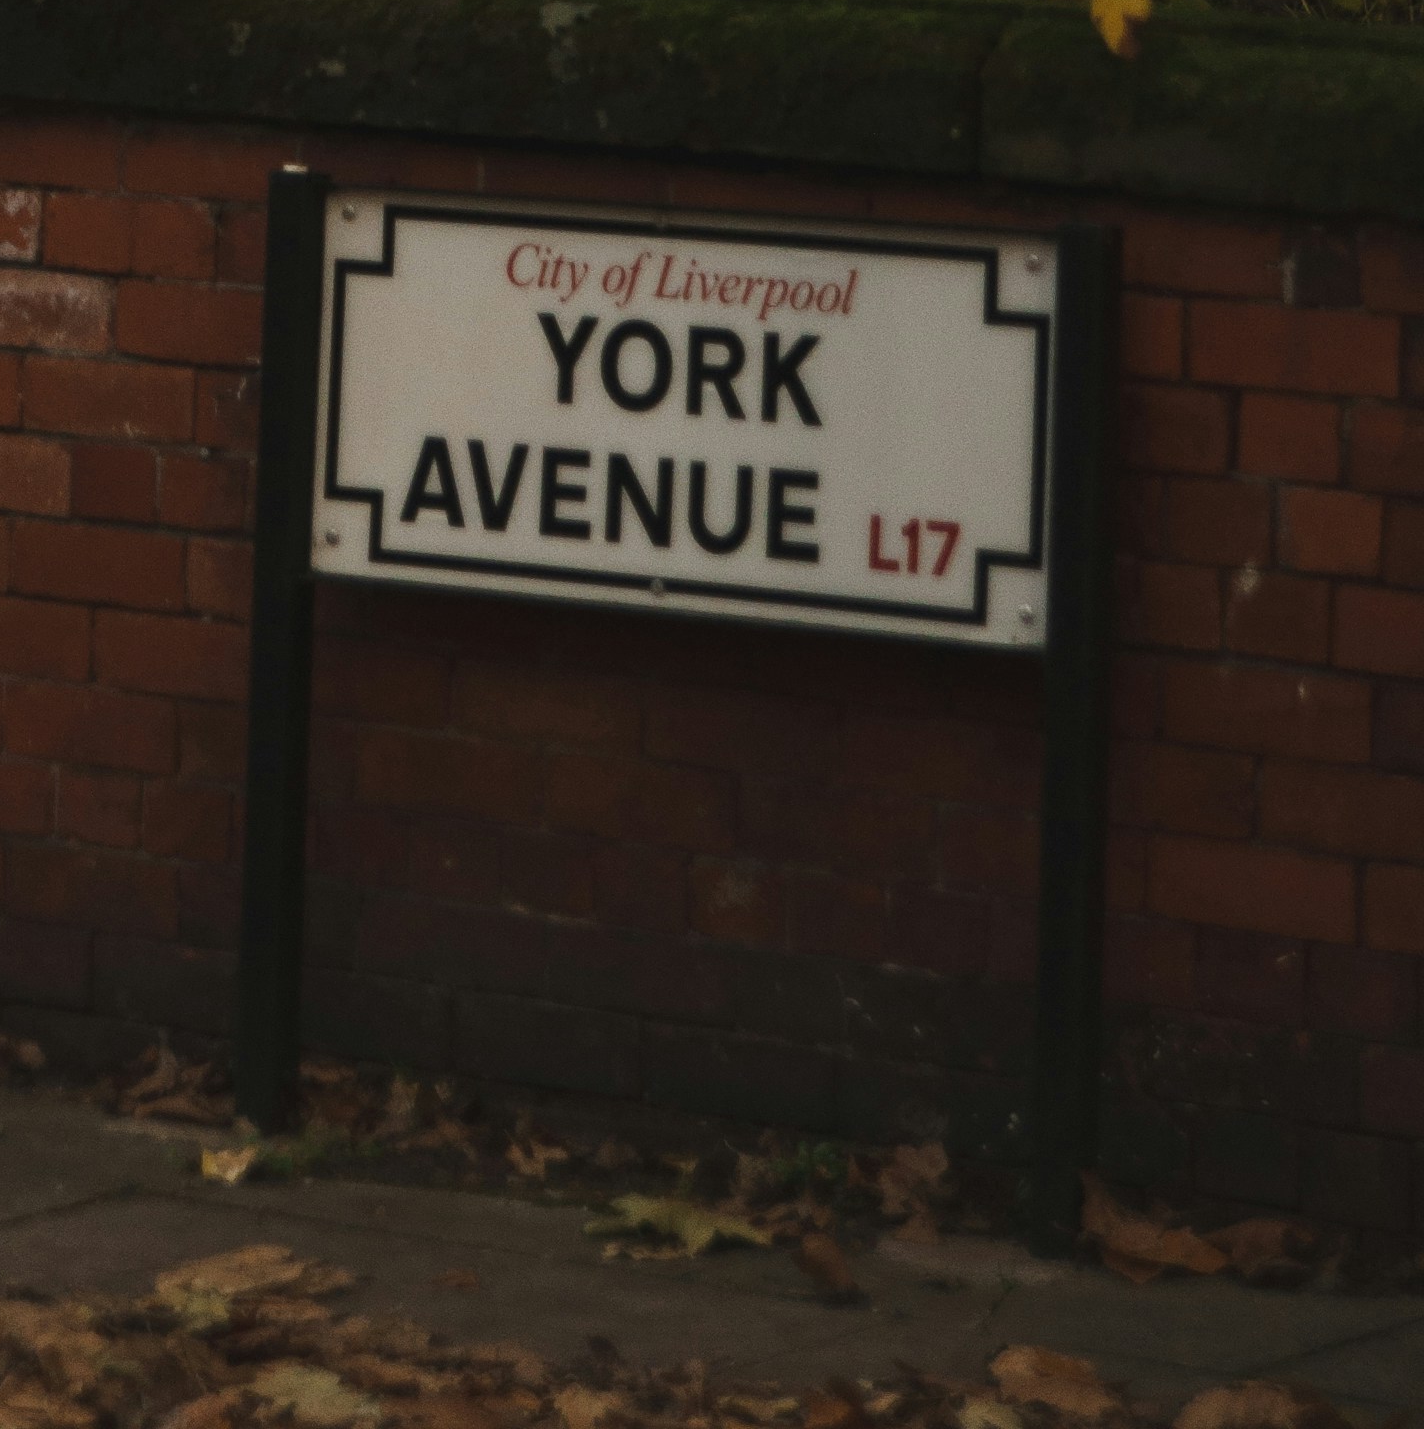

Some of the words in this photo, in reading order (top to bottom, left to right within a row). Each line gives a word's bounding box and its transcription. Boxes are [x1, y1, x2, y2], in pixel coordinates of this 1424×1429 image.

[506, 242, 588, 301] City
[601, 252, 653, 306] of
[656, 254, 859, 321] Liverpool
[538, 312, 823, 427] YORK
[399, 436, 821, 563] AVENUE
[867, 514, 962, 577] L17
